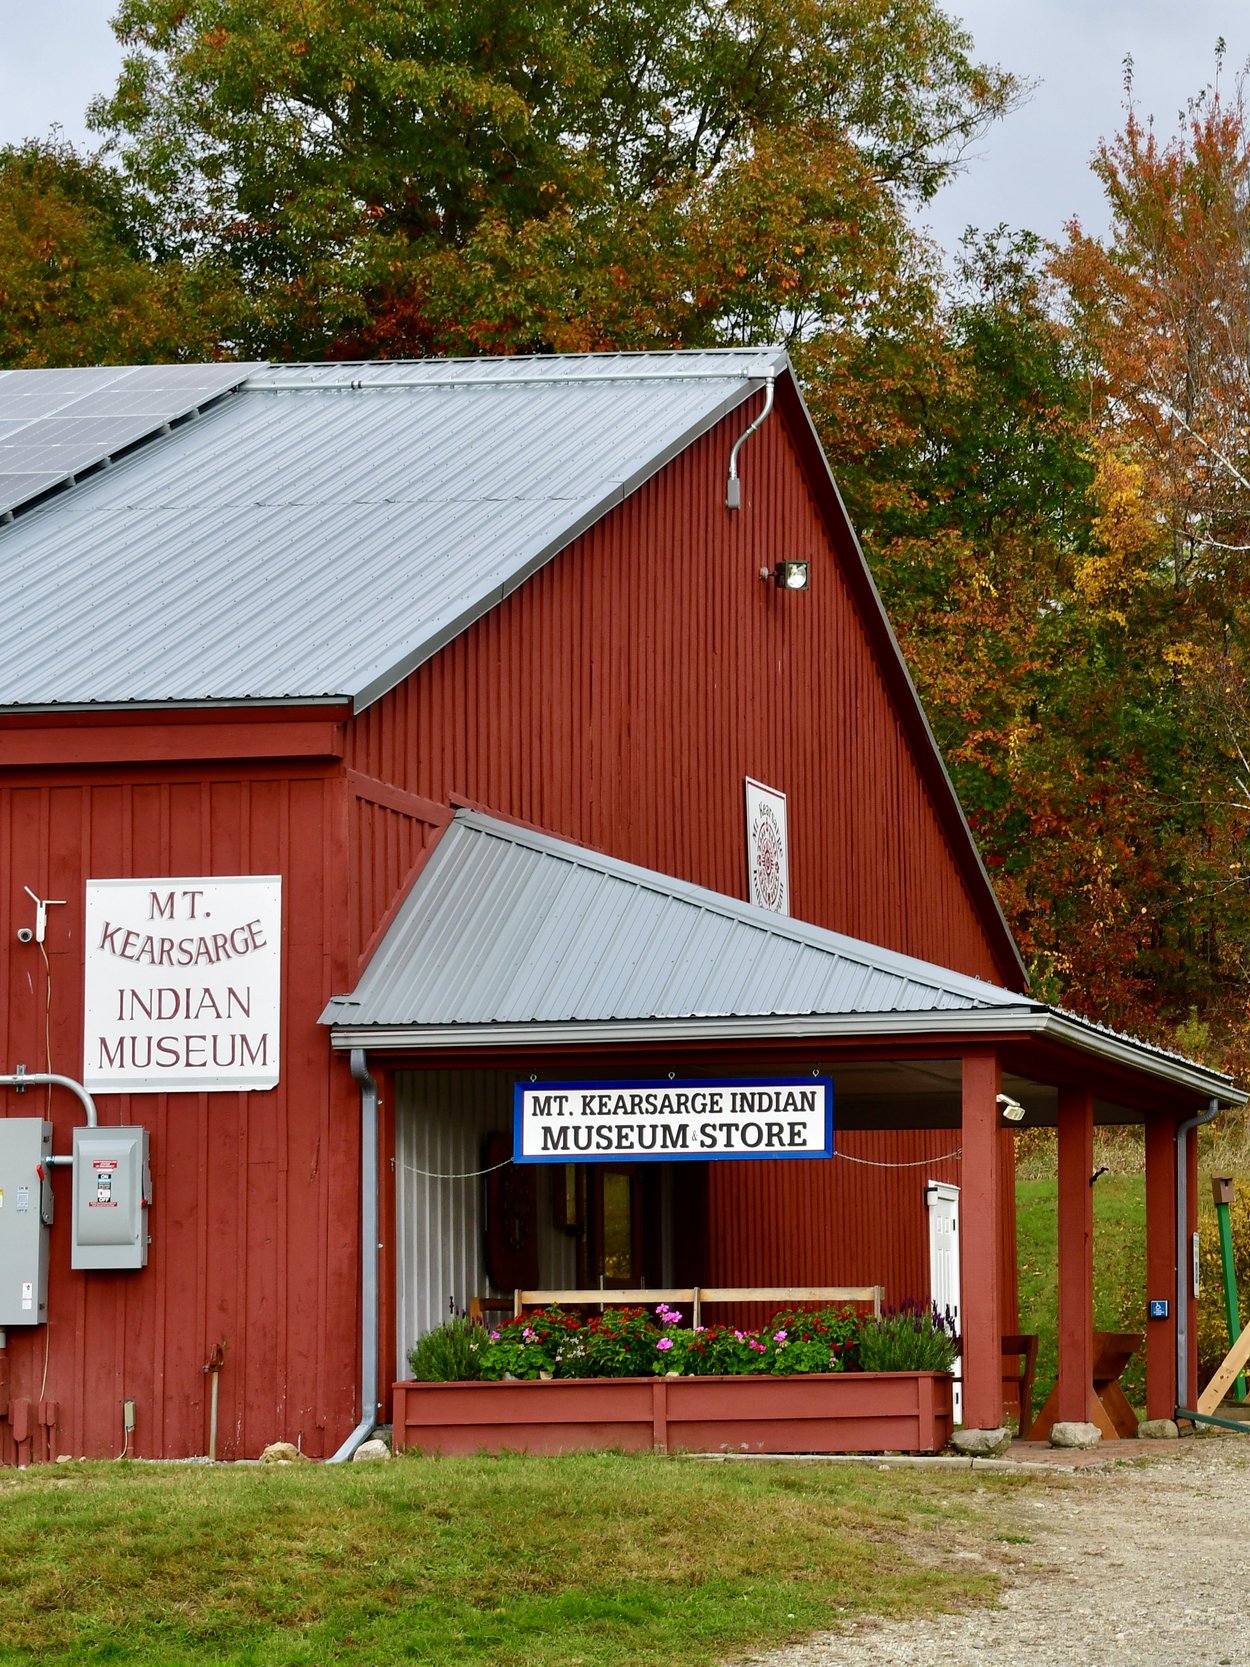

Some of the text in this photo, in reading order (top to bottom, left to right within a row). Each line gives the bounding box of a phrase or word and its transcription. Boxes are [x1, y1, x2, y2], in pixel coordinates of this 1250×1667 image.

[149, 891, 211, 920] MT.
[99, 919, 267, 967] KEARSARGE
[117, 986, 251, 1021] INDIAN
[98, 1033, 269, 1069] MUSEUM
[531, 1090, 817, 1117] MT. KEARSARGE INDIAN
[541, 1123, 690, 1151] MUSEUM
[699, 1121, 807, 1149] STORE
